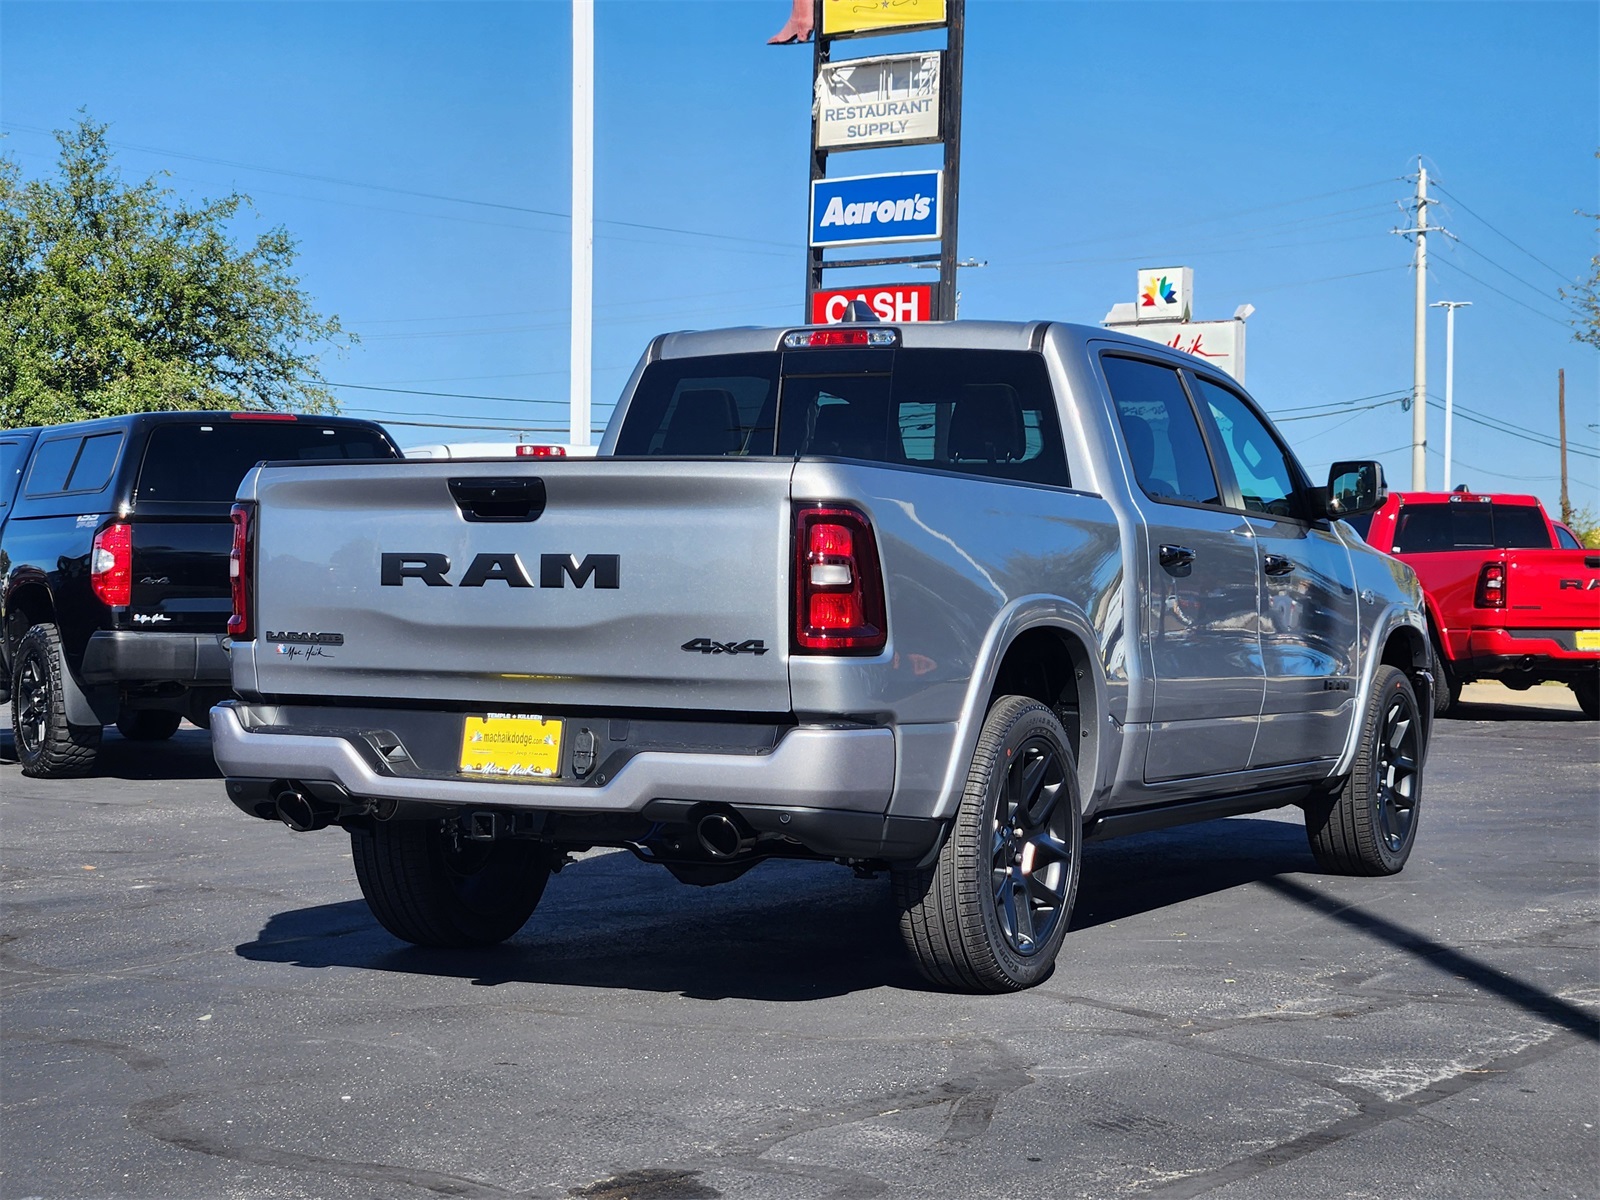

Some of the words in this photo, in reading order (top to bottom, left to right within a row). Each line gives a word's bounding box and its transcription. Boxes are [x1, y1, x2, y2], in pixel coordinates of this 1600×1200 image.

[825, 99, 933, 121] RESTAURANT
[847, 120, 909, 138] SUPPLY
[820, 193, 931, 227] Aaron's
[381, 553, 620, 589] RAM
[681, 638, 770, 656] 4x4
[483, 731, 543, 746] machaikdodge.com
